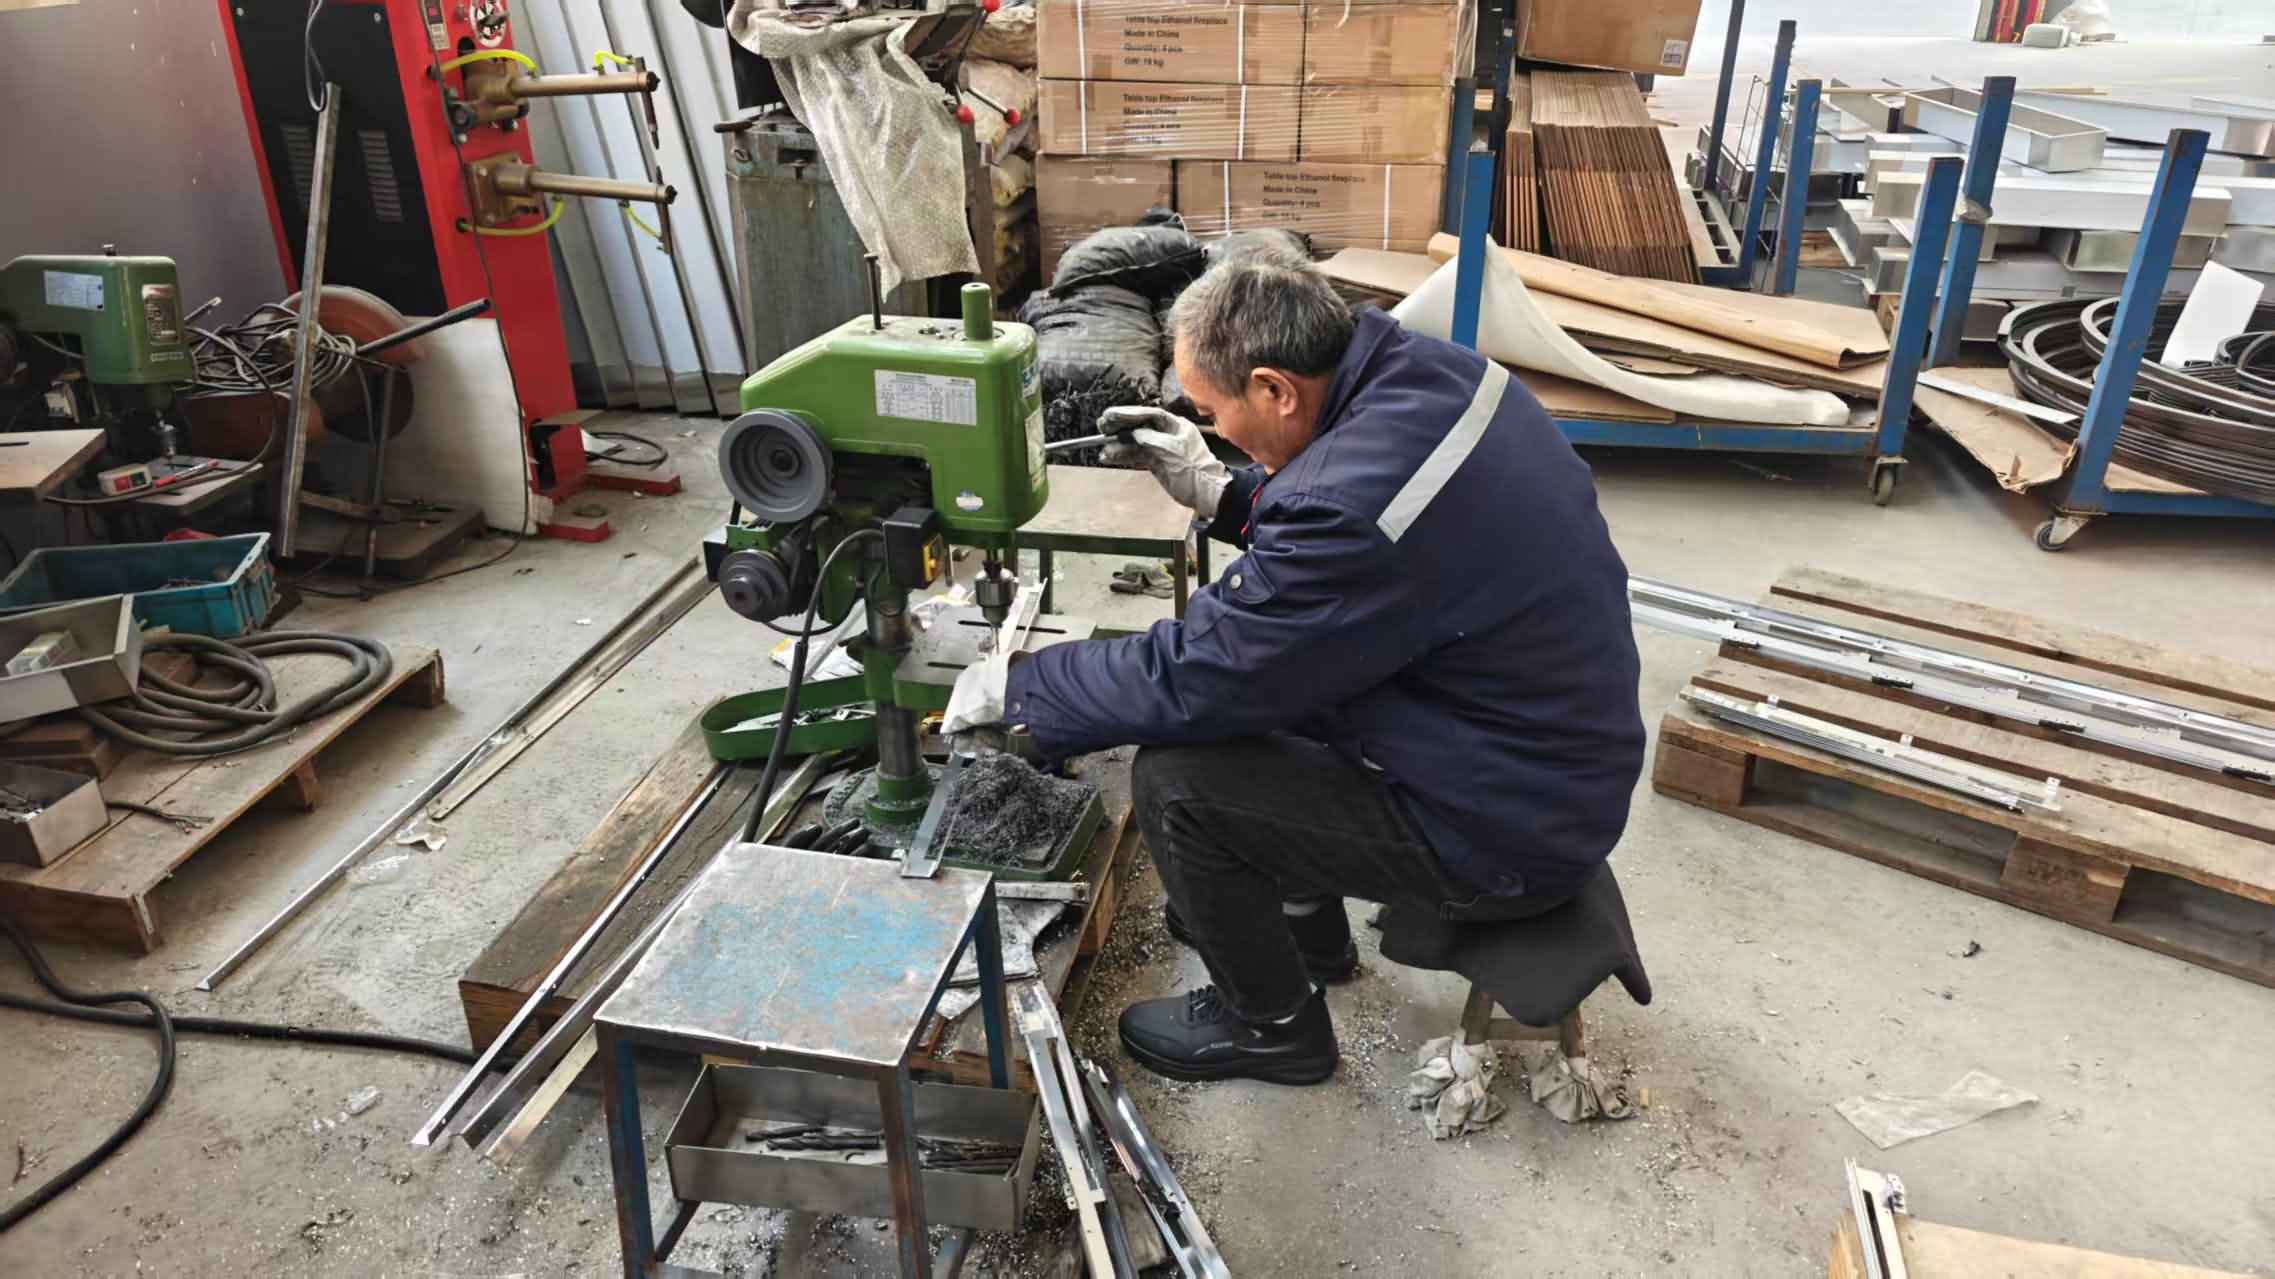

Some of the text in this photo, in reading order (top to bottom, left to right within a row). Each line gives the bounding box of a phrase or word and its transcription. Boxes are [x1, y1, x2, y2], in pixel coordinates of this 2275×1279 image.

[1161, 15, 1192, 25] Ethanol
[1124, 28, 1145, 38] Made
[1156, 30, 1180, 39] China
[1122, 93, 1145, 102] Table
[1160, 94, 1190, 103] Ethanol
[1123, 106, 1145, 115] Made
[1263, 170, 1284, 180] Table
[1300, 171, 1330, 182] Ethanol
[1264, 186, 1284, 194] Made
[1295, 186, 1318, 195] China
